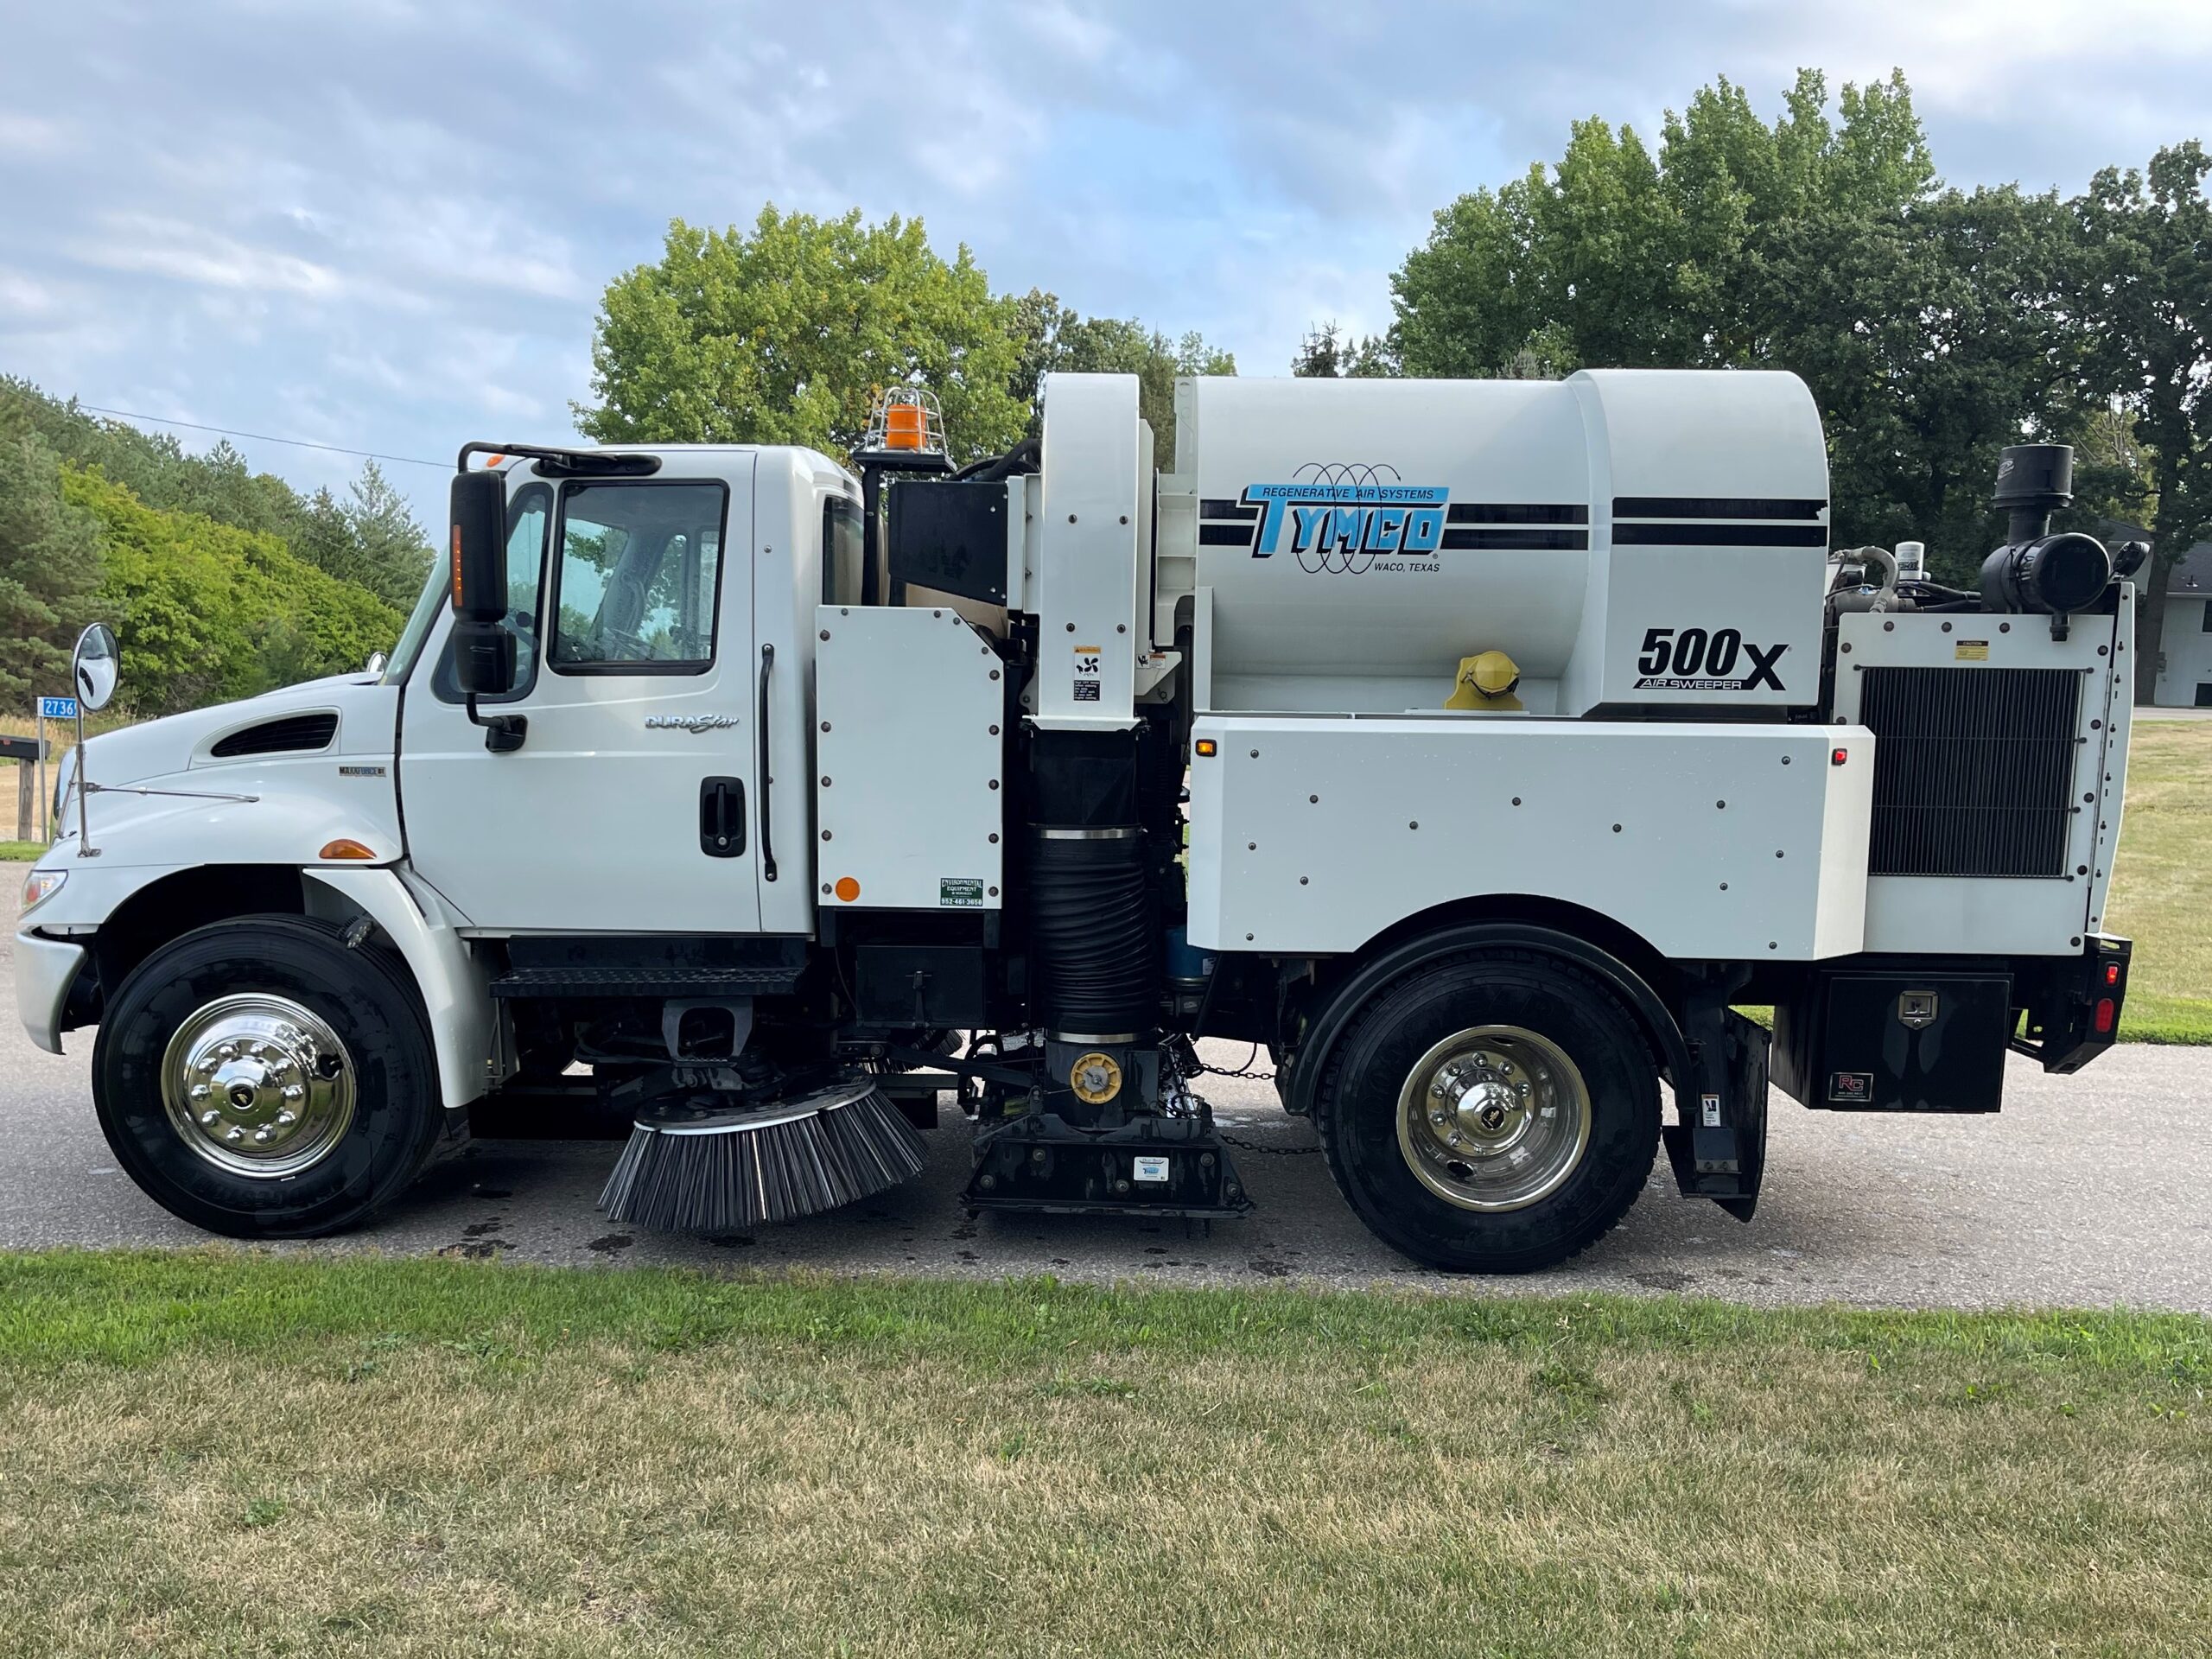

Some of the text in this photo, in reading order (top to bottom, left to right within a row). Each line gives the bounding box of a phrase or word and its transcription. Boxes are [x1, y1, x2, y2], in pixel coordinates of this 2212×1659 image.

[1262, 487, 1434, 499] REGENERATIVE AIR SYSTEMS
[1240, 484, 1449, 558] TYMCO
[1374, 563, 1440, 573] WACO, TEXAS
[1639, 678, 1742, 690] AIR SWEEPER
[45, 700, 77, 715] 2736
[1839, 1075, 1864, 1091] RC
